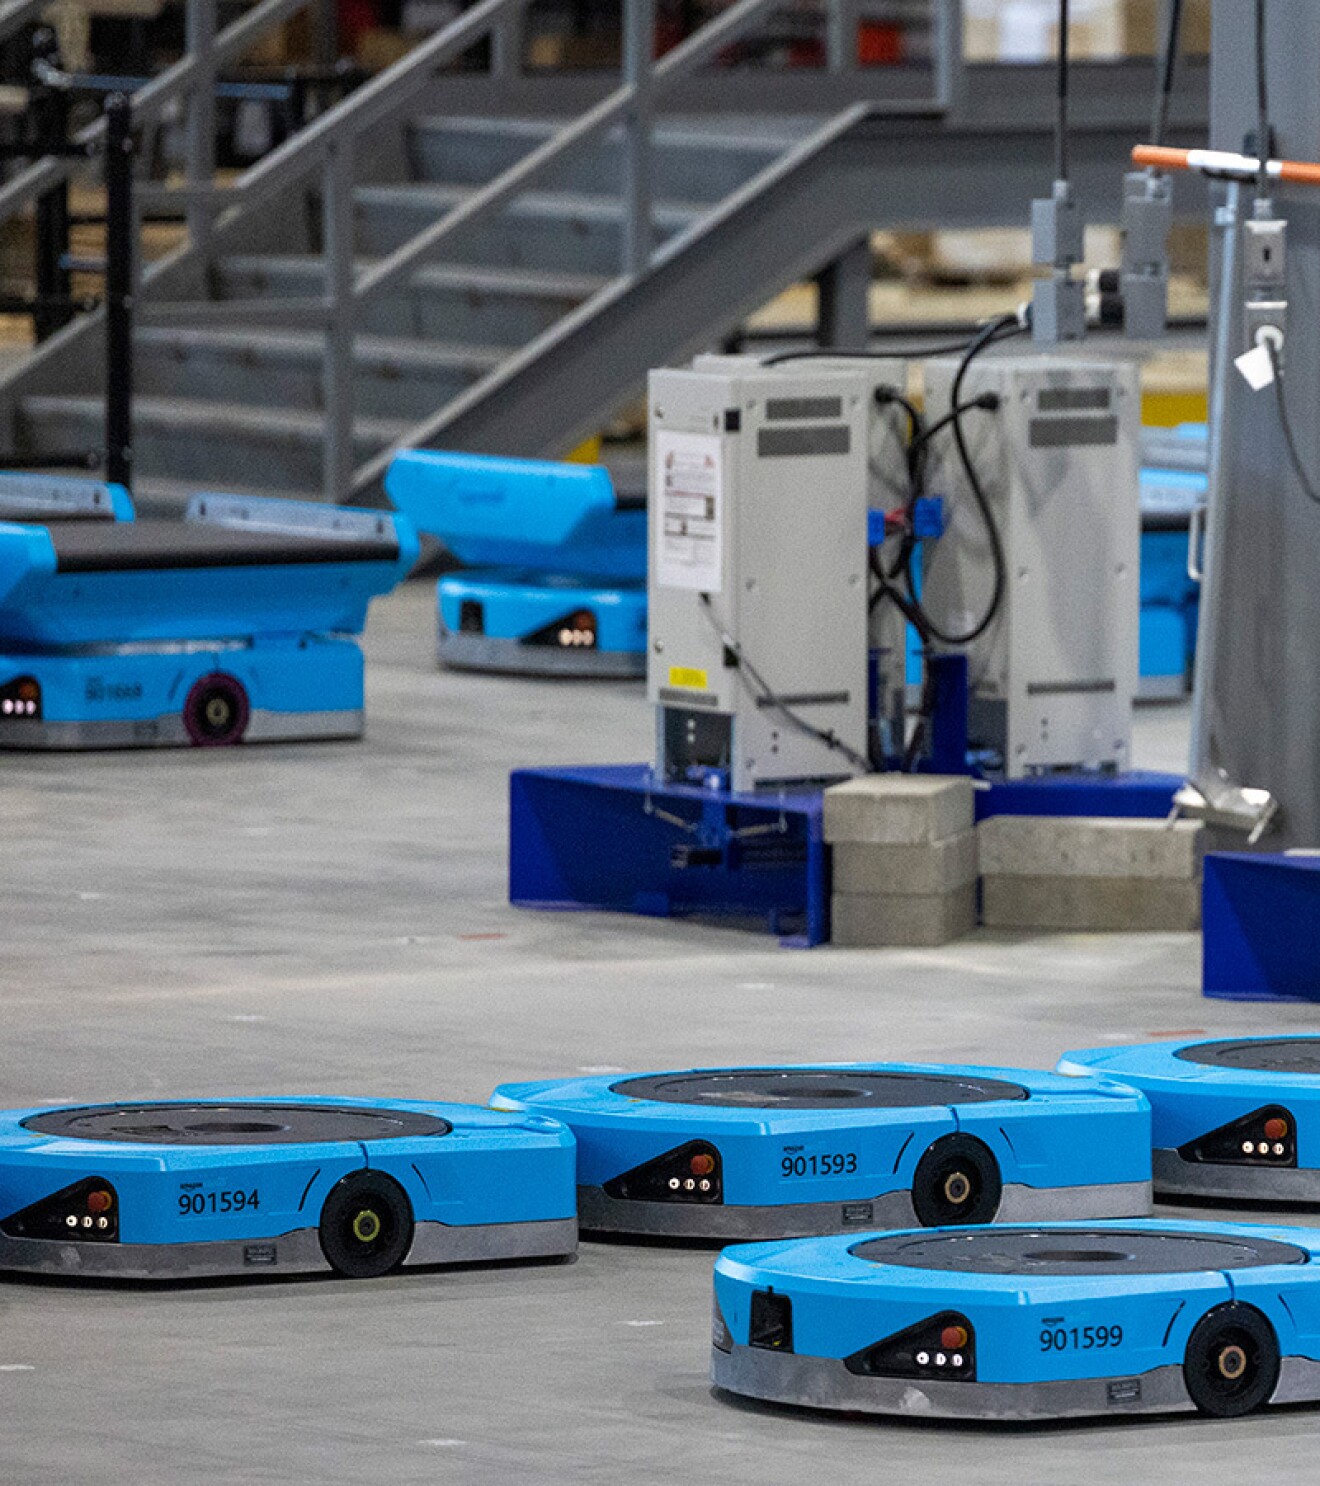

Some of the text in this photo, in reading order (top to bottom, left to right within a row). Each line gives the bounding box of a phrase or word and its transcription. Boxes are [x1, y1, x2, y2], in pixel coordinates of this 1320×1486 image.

[781, 1152, 857, 1177] 901593
[178, 1189, 260, 1215] 901594
[1040, 1325, 1123, 1352] 901599
